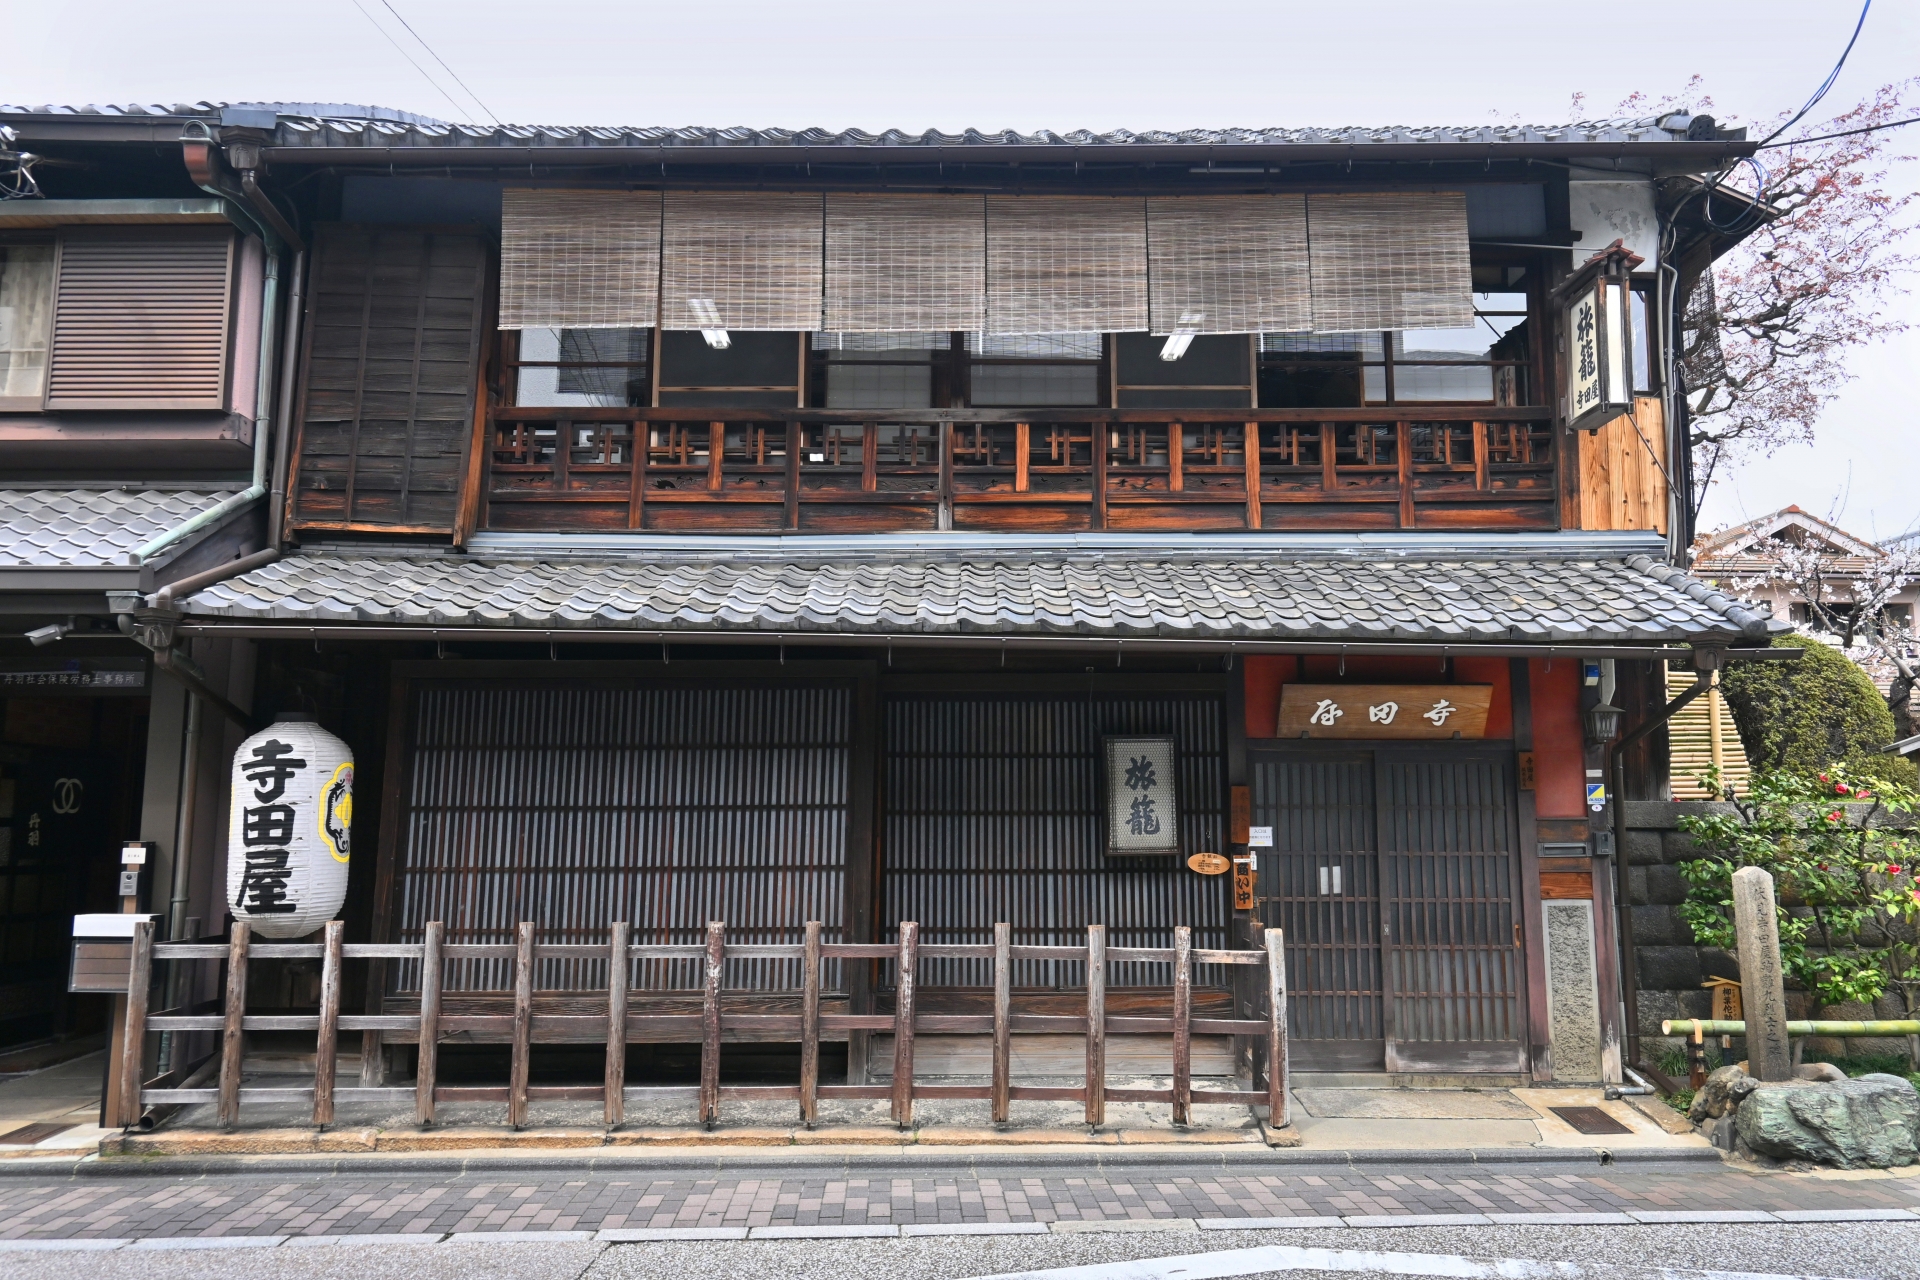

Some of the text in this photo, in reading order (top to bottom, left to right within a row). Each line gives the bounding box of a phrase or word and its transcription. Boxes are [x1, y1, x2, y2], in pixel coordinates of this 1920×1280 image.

[1577, 302, 1596, 382] 旅籠
[1577, 379, 1599, 409] 寺田屋
[236, 739, 307, 914] 寺田屋
[1125, 755, 1161, 836] 旅籠
